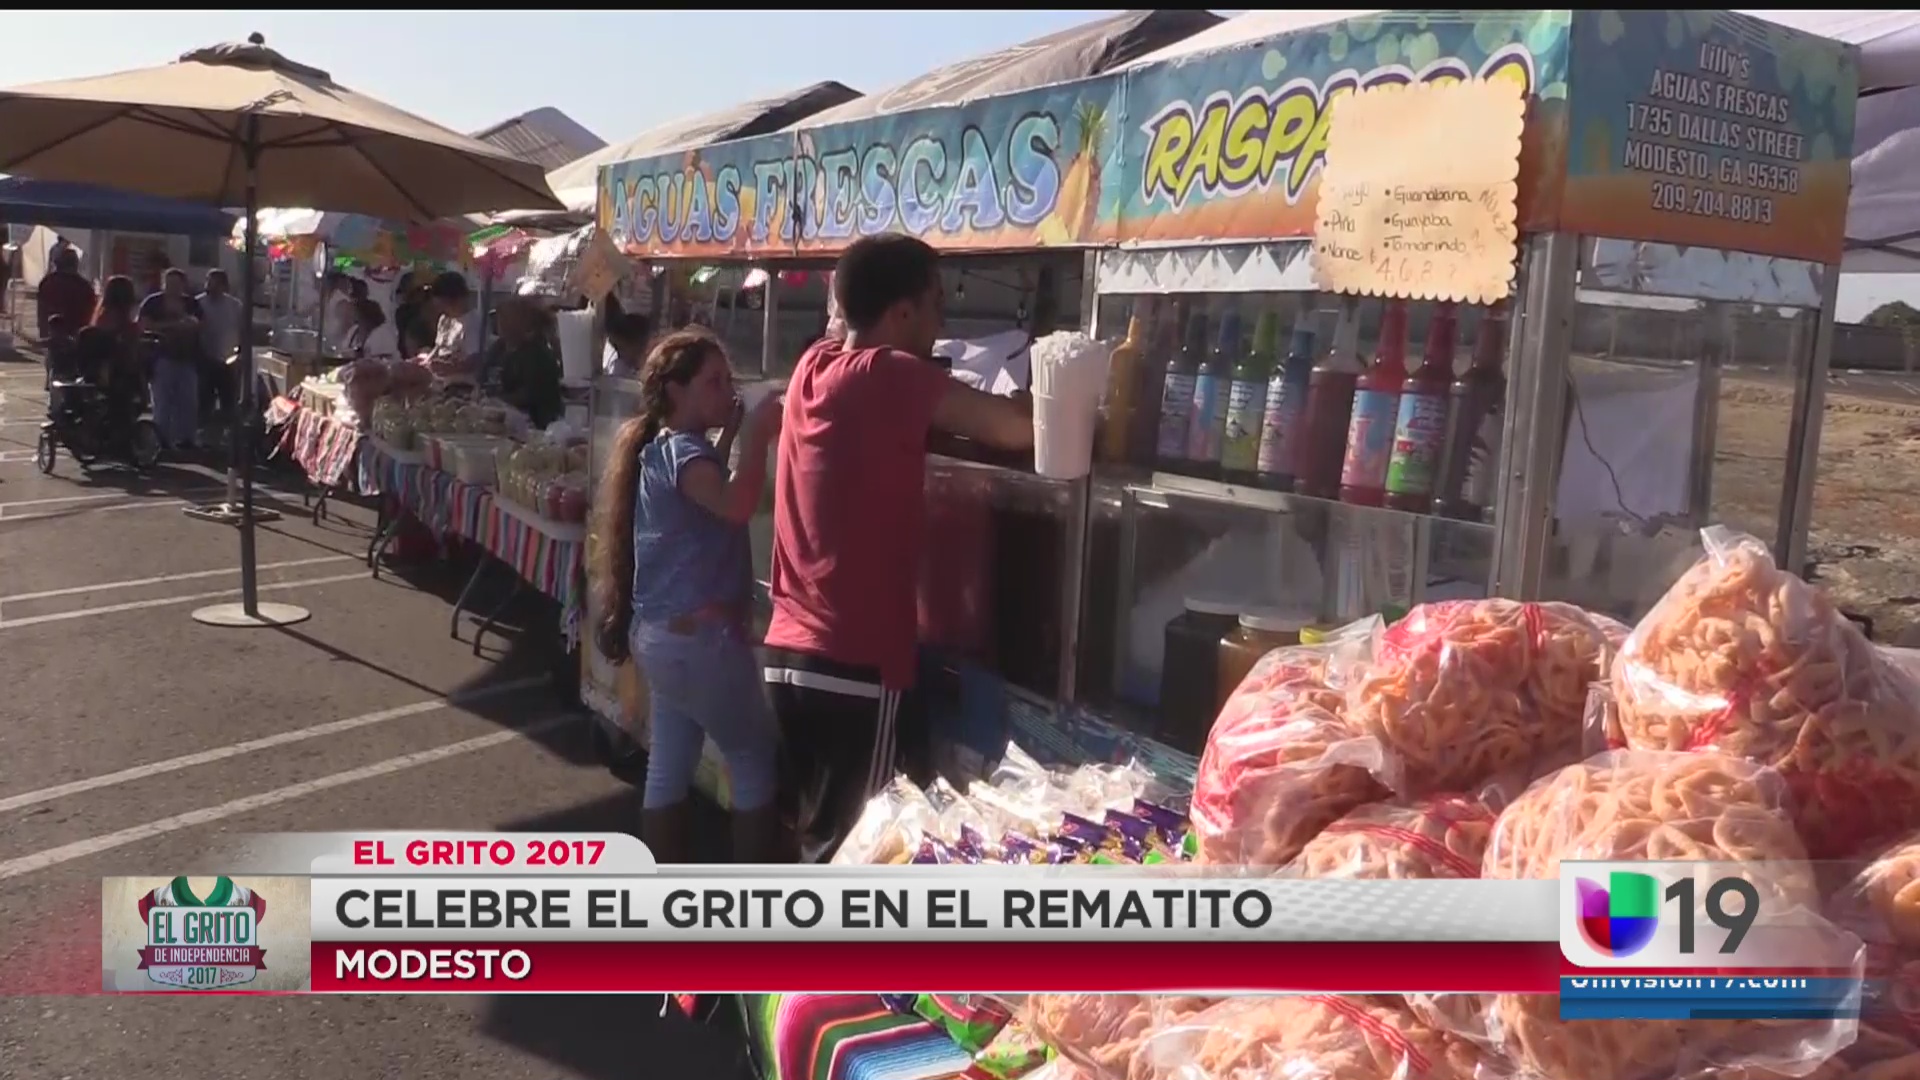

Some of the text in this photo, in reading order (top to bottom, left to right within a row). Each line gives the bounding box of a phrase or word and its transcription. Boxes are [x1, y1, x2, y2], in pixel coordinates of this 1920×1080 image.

[1700, 42, 1750, 79] Lilly's
[1650, 69, 1789, 123] AGUAS FRESCAS
[1627, 102, 1804, 160] 1735 DALLAS STREET
[609, 111, 1061, 244] AGUAS FRESCAS
[1720, 157, 1742, 185] CA
[1748, 161, 1799, 193] 95358
[1651, 182, 1772, 224] 209.204.8813
